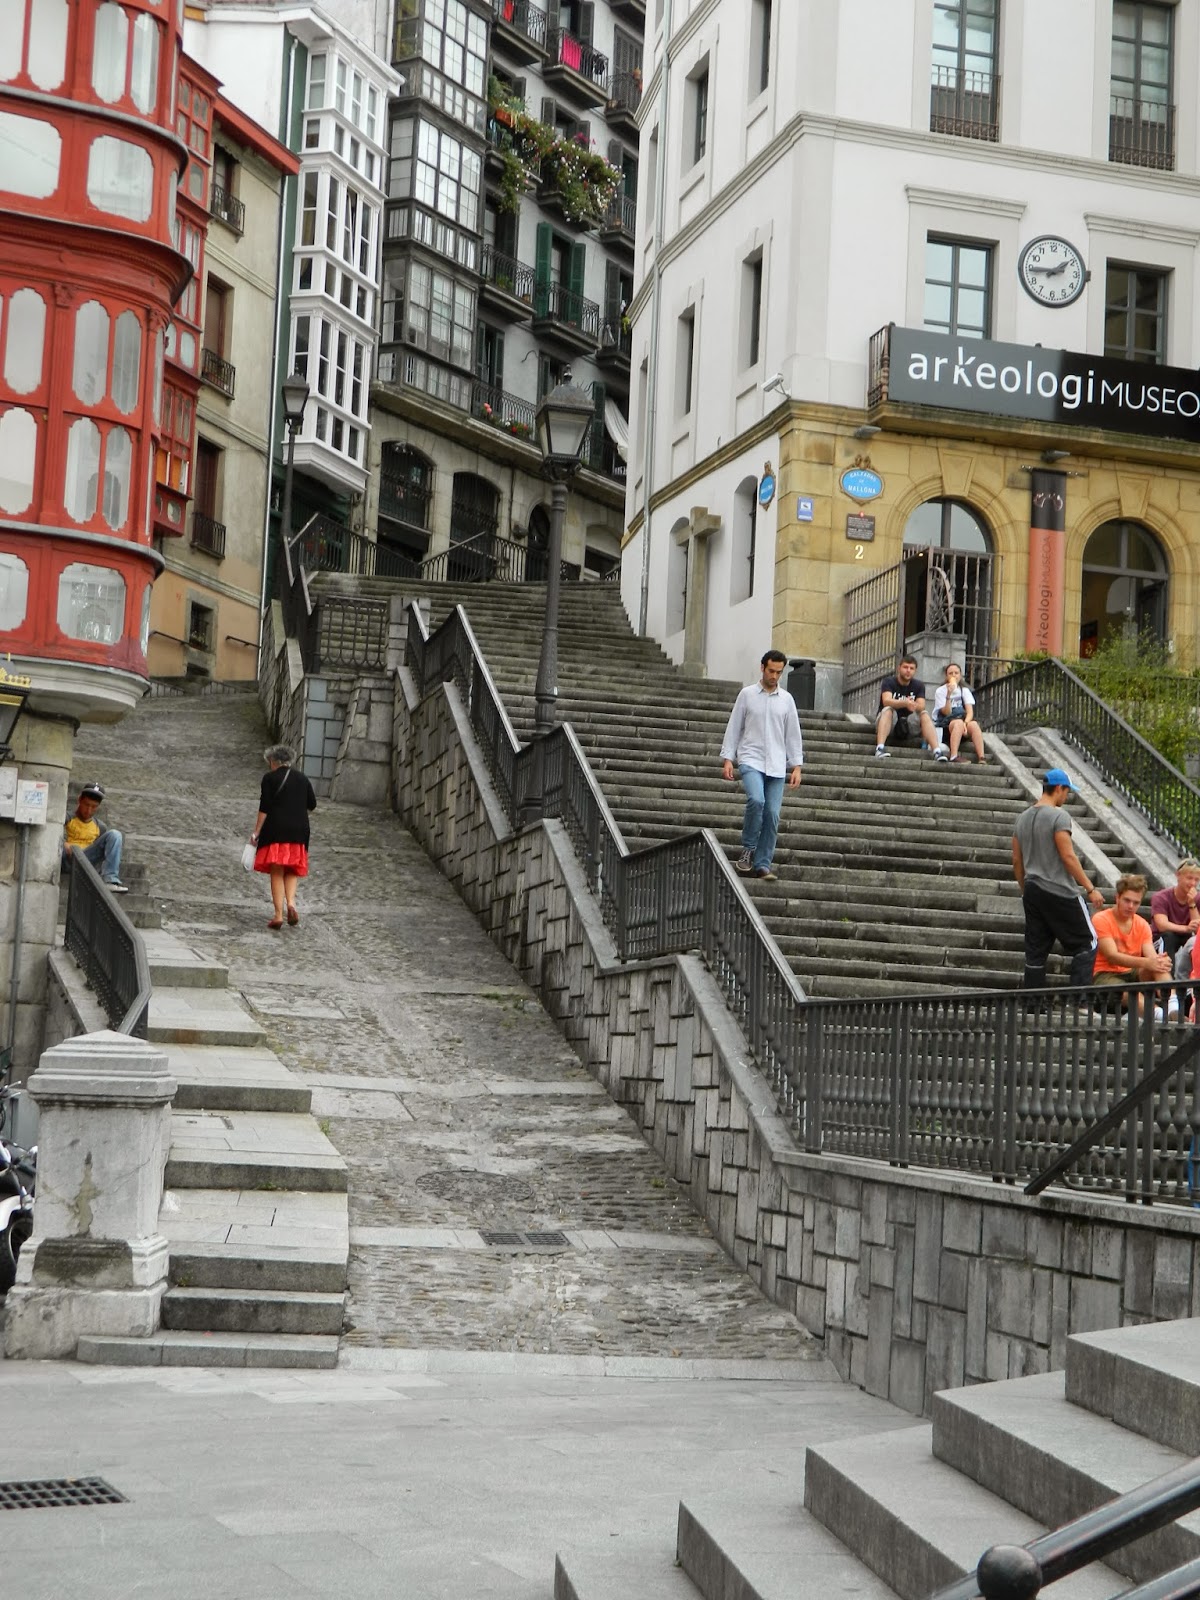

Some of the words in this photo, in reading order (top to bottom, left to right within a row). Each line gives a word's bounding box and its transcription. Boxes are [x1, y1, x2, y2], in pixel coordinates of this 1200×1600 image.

[1050, 245, 1058, 253] 12
[1032, 254, 1040, 262] 10
[907, 346, 1095, 409] arkeologi
[1100, 380, 1200, 418] MUSEO
[848, 485, 876, 494] MALLONA
[855, 545, 864, 559] 2
